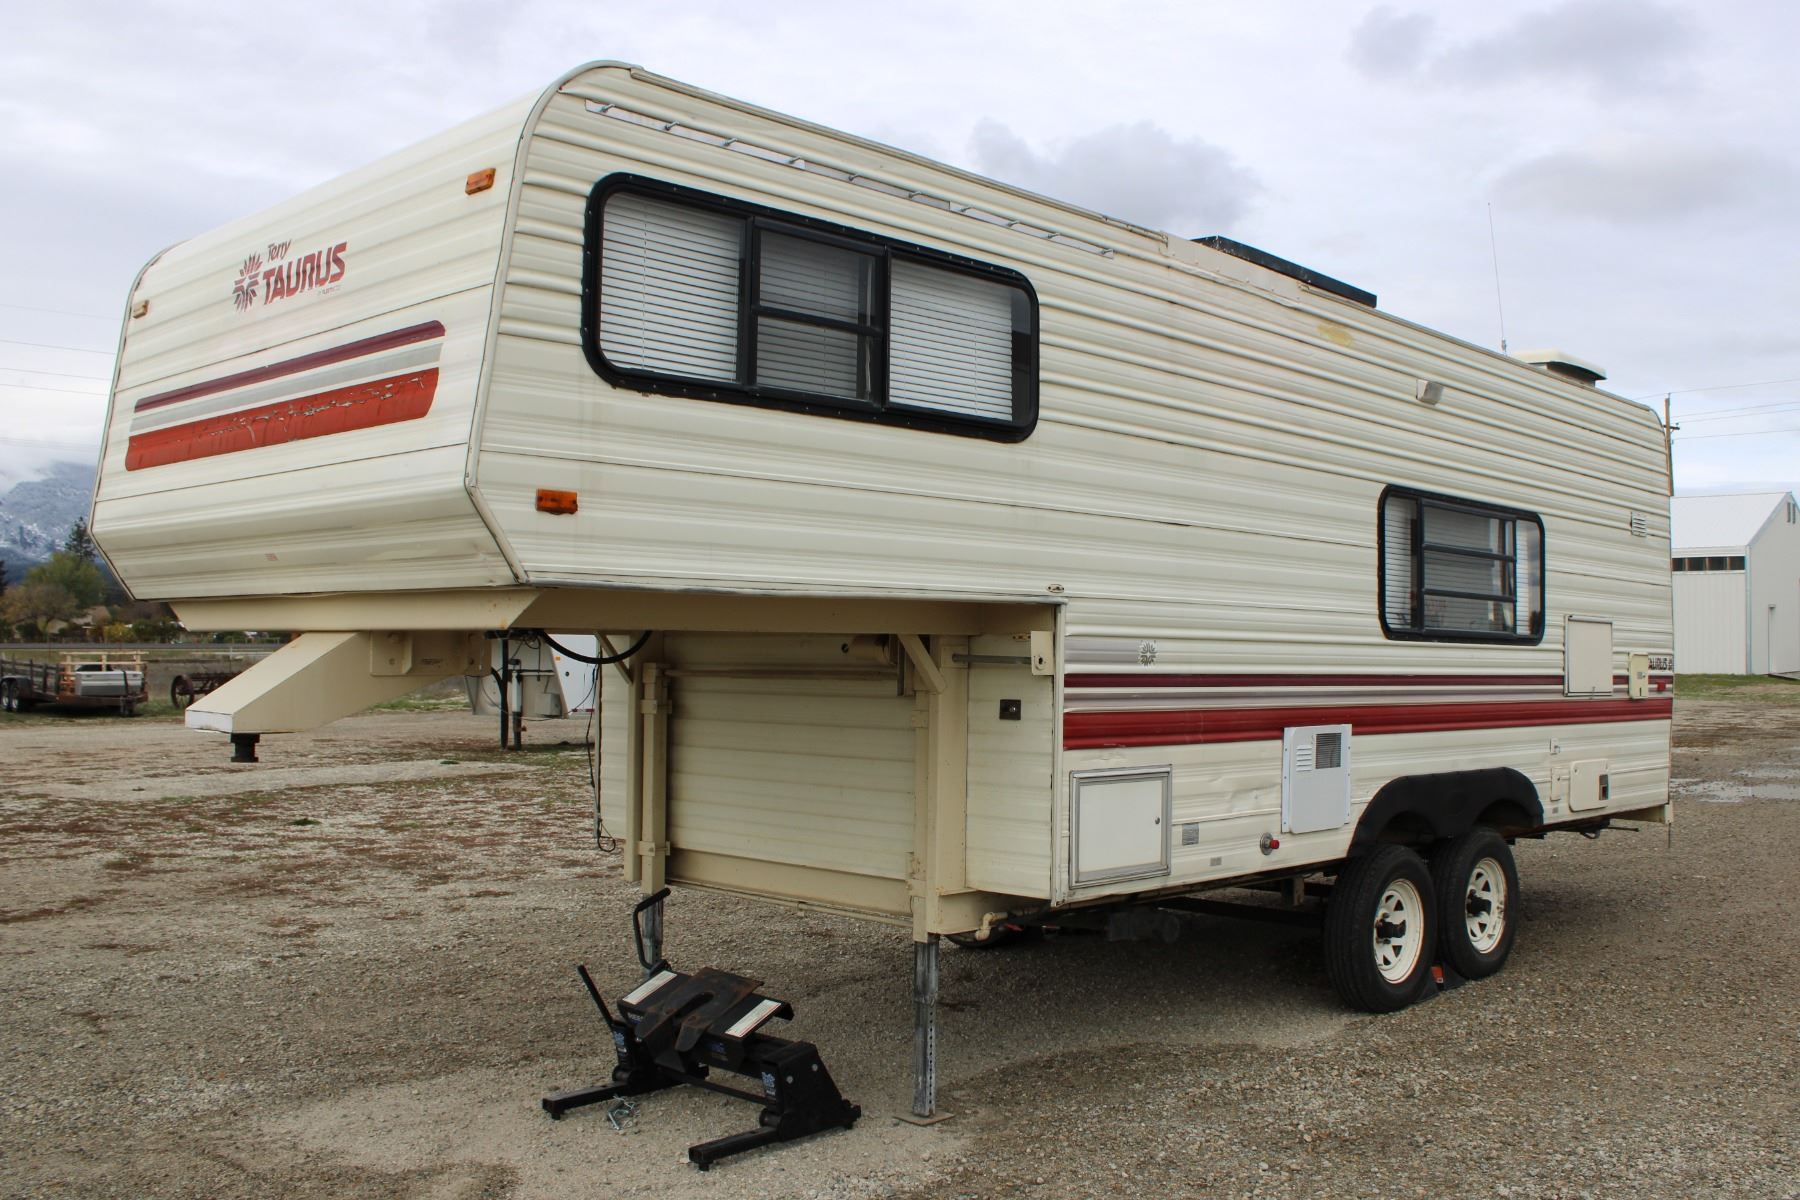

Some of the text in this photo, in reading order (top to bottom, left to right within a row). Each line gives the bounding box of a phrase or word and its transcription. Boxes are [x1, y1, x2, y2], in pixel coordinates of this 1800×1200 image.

[267, 239, 292, 263] Terry
[262, 241, 347, 305] TAURUS
[1648, 657, 1667, 671] AURUS
